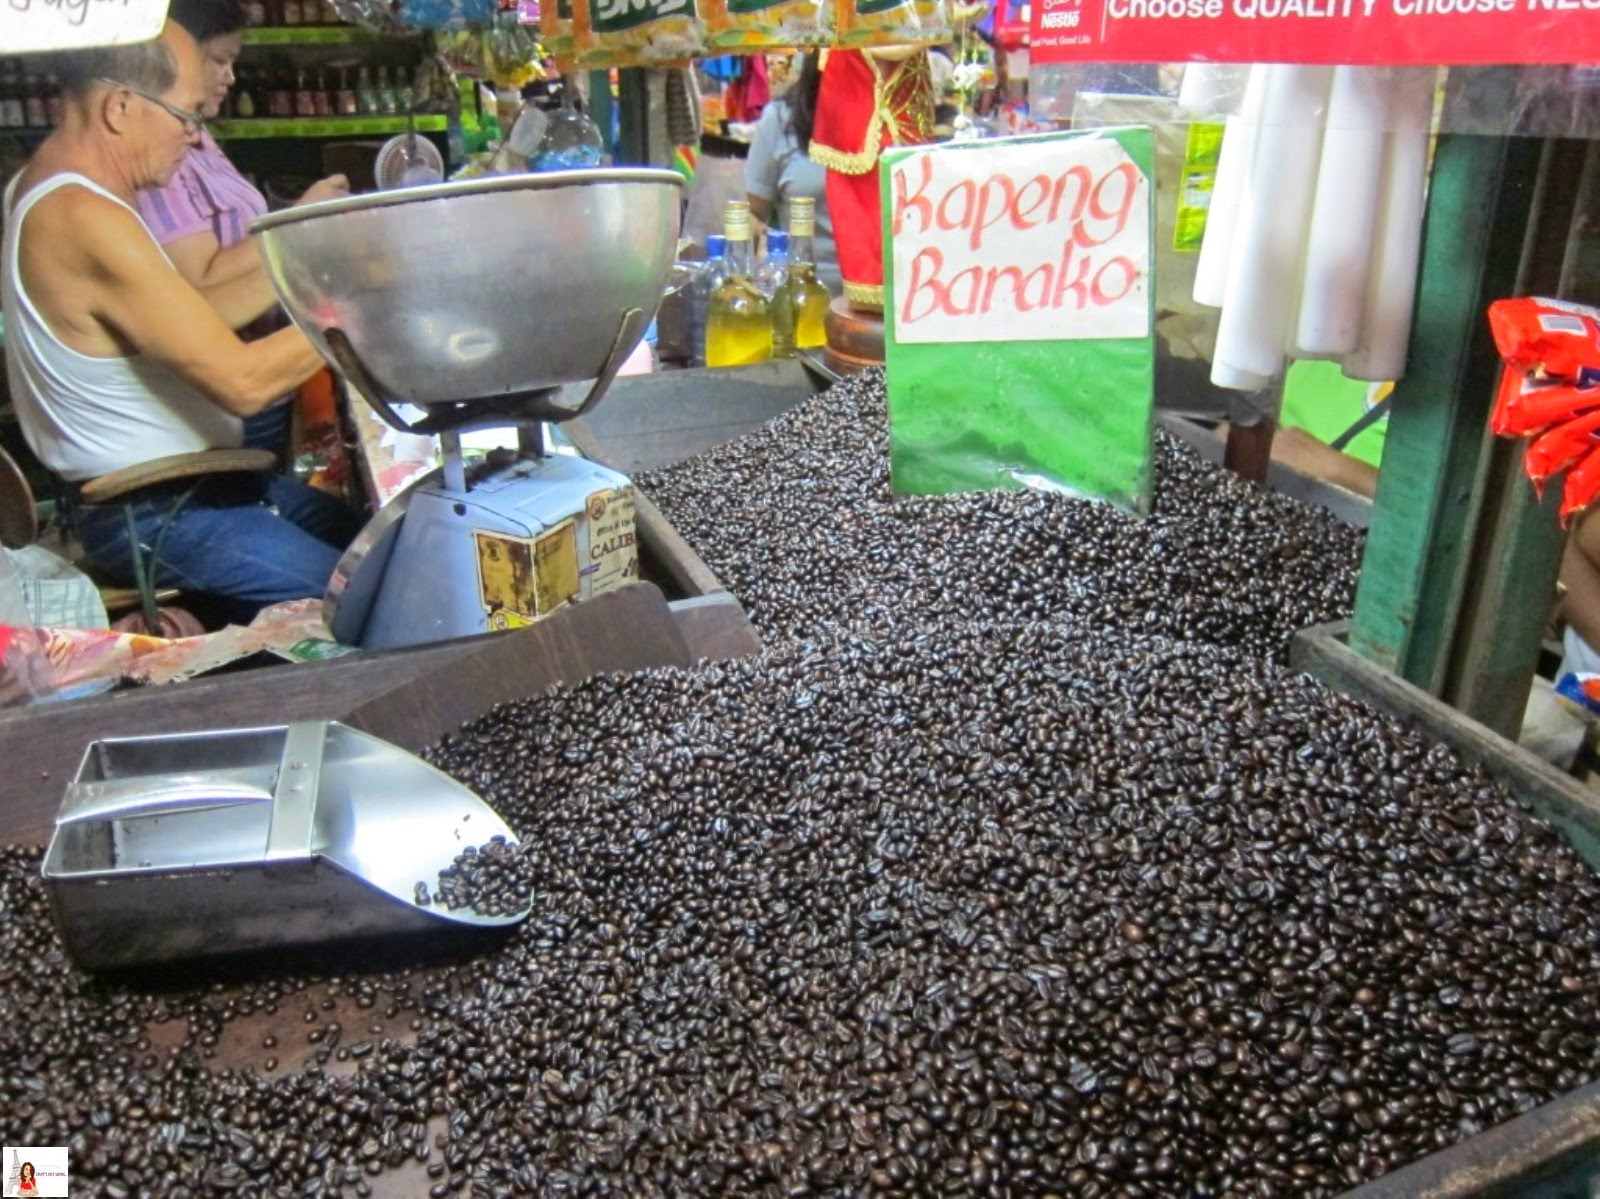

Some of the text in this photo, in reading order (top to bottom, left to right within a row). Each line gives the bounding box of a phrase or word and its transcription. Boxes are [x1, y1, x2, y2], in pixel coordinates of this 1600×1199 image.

[1108, 0, 1223, 18] Choose
[893, 154, 1138, 252] Kapeng
[902, 239, 1138, 324] Barako
